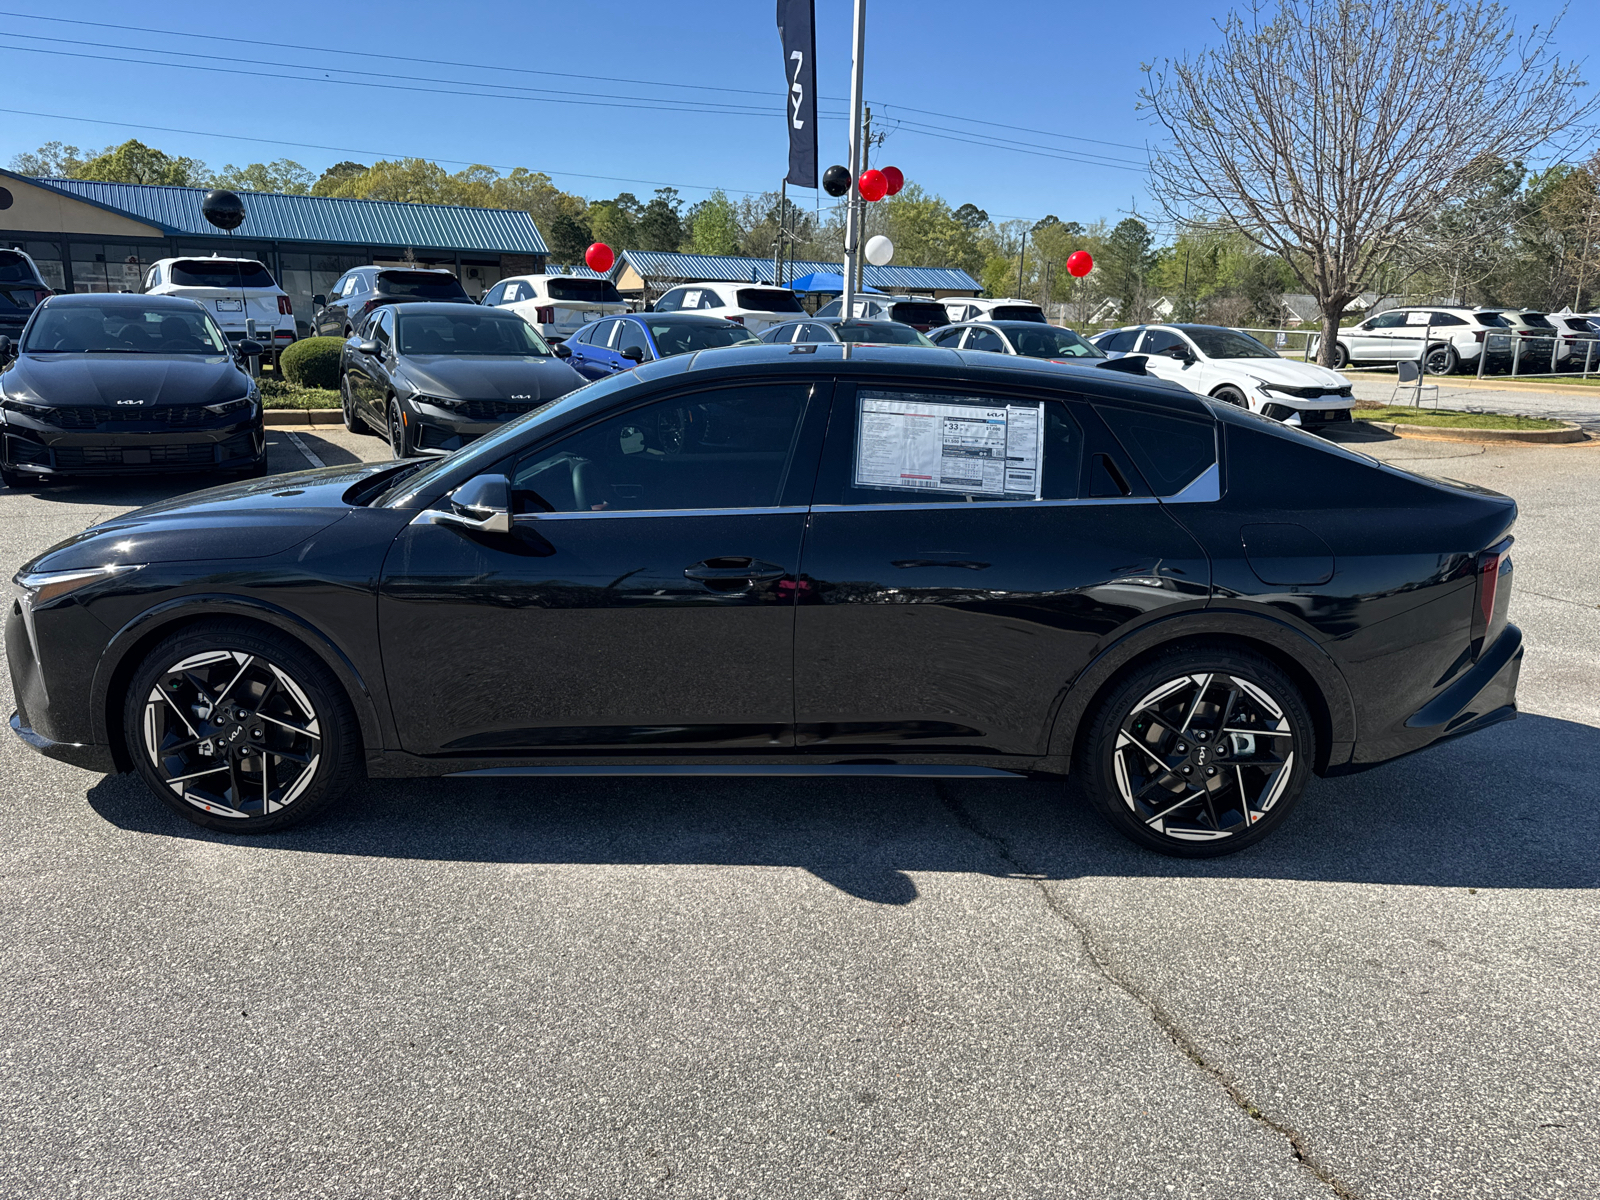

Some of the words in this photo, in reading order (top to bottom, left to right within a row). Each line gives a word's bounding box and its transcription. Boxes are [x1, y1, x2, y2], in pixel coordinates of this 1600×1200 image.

[948, 423, 959, 431] 33
[228, 725, 243, 742] KIA
[1197, 746, 1206, 766] KIA
[282, 786, 324, 822] KUMHO
